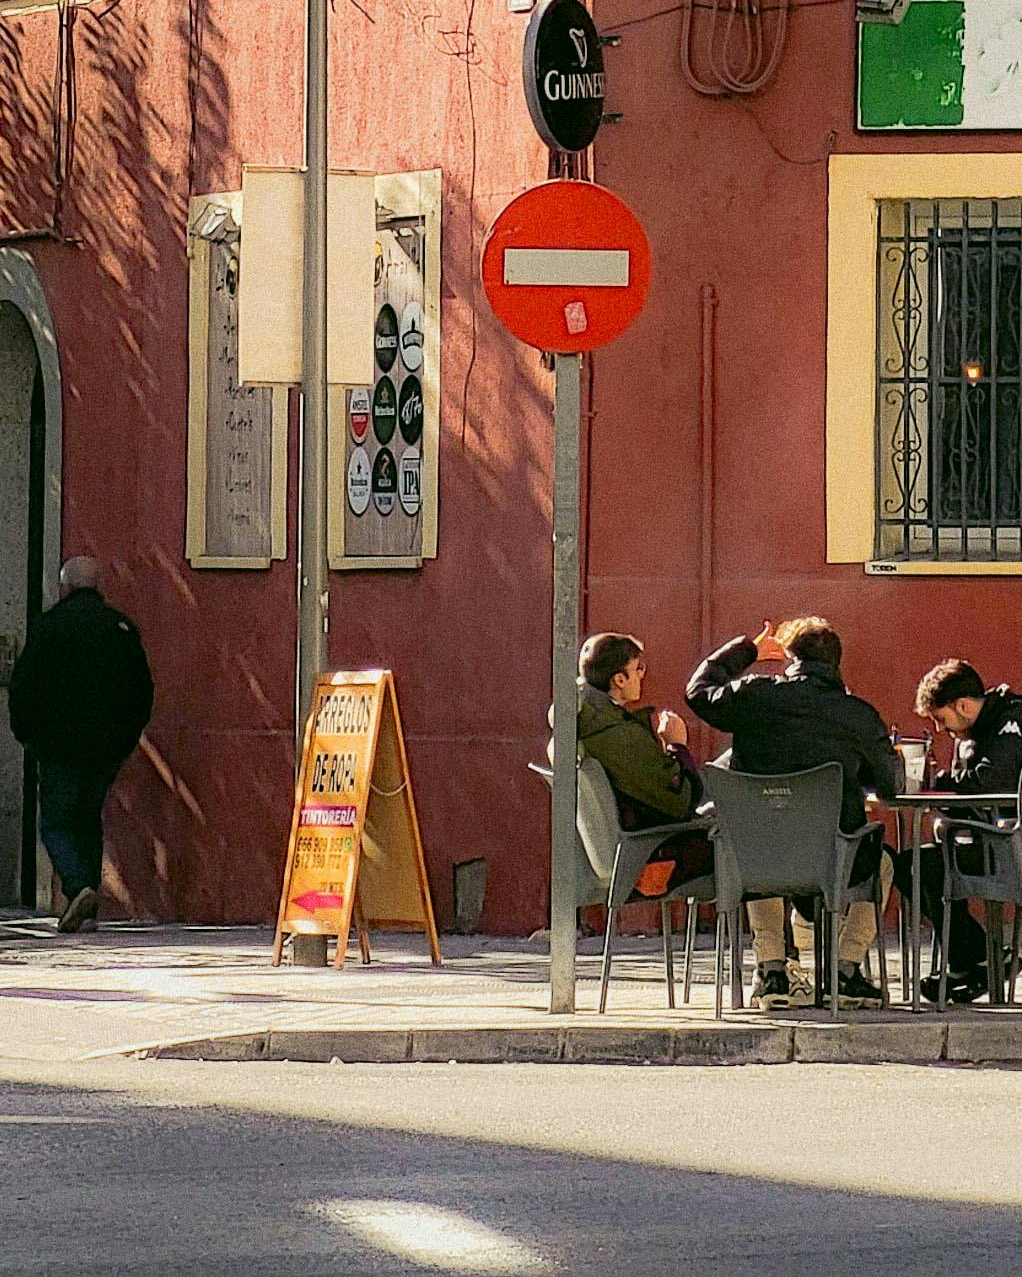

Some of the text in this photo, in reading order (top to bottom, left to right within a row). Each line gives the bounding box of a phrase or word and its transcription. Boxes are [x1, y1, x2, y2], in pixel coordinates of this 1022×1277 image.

[544, 69, 605, 101] GUINNE
[404, 470, 420, 495] IPA
[315, 694, 373, 734] ARREGLOS
[312, 753, 357, 793] DE ROPA
